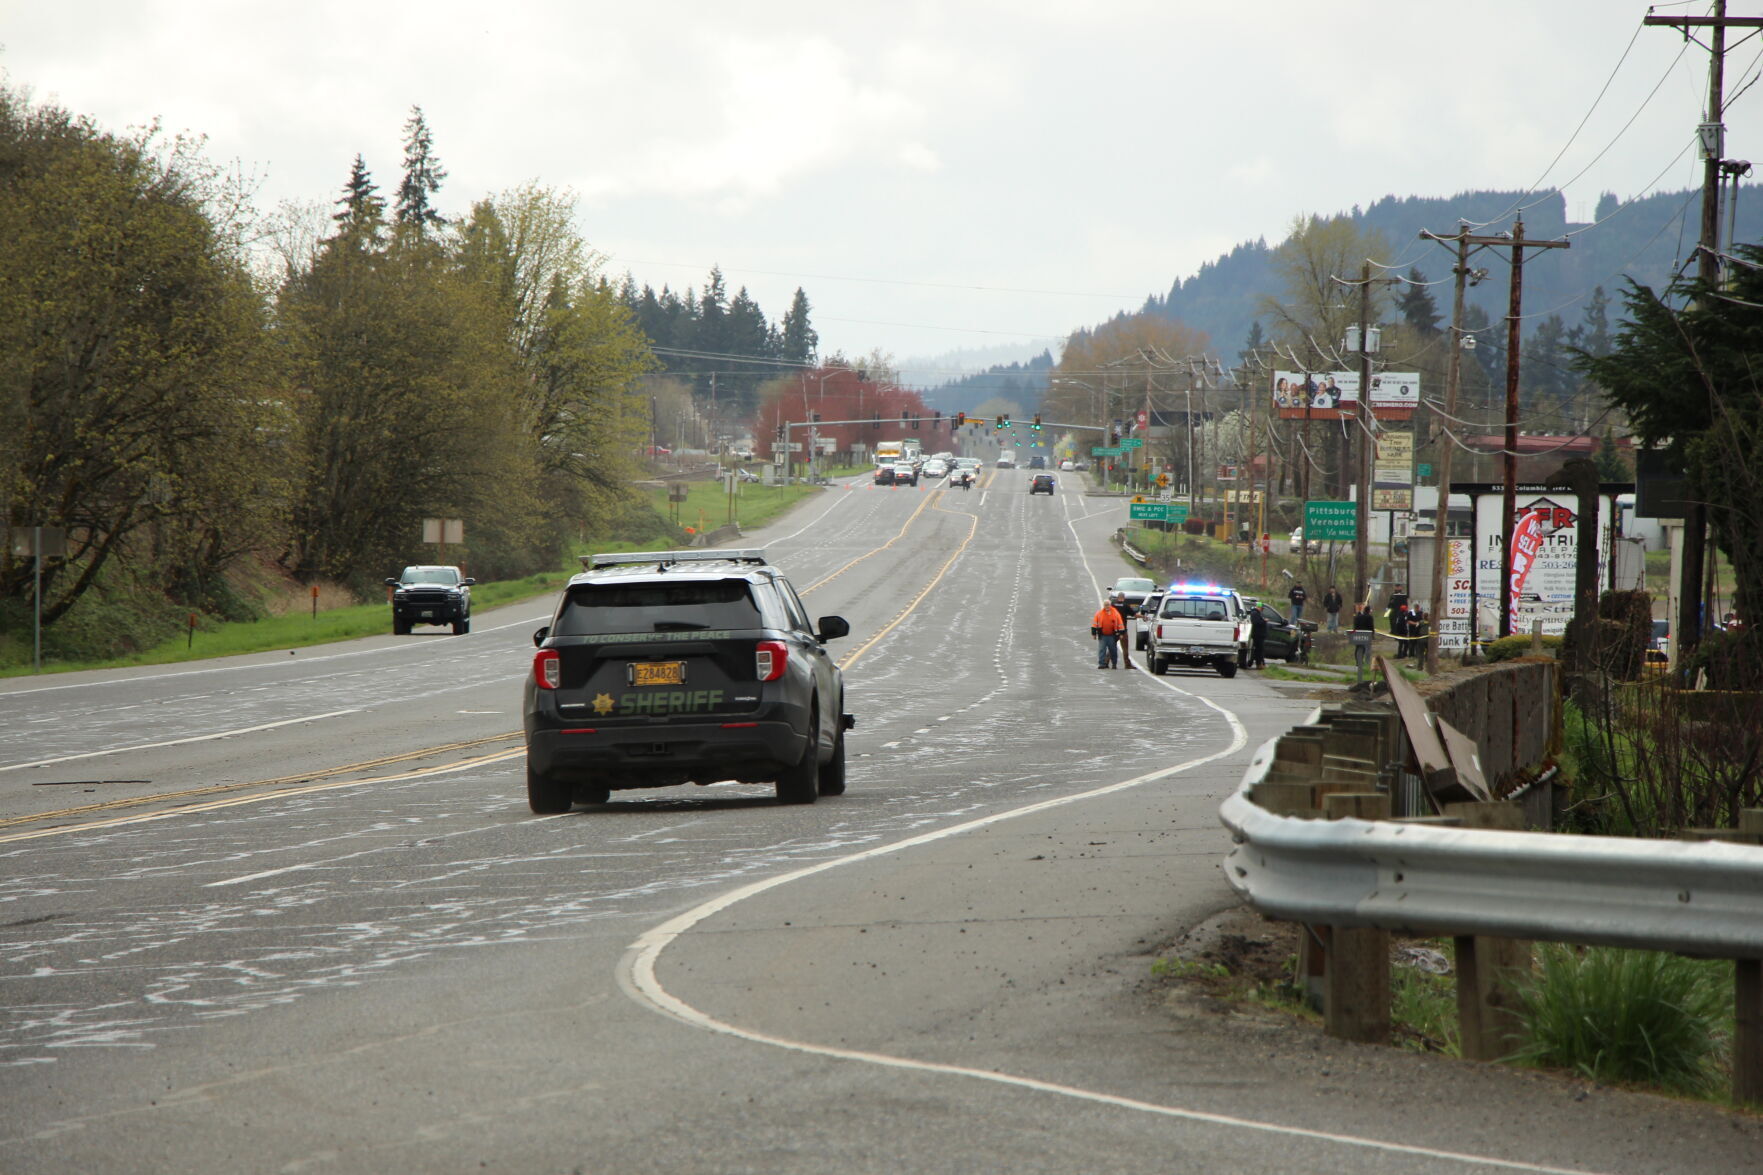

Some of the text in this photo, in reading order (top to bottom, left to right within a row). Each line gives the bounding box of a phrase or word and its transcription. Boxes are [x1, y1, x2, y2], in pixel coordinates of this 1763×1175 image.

[1309, 507, 1356, 516] Pittsburg
[1311, 518, 1355, 526] Vernonia
[1518, 534, 1536, 556] SELL
[583, 630, 731, 644] TO CONSERVE THE PEACE
[619, 690, 723, 714] SHERIFF
